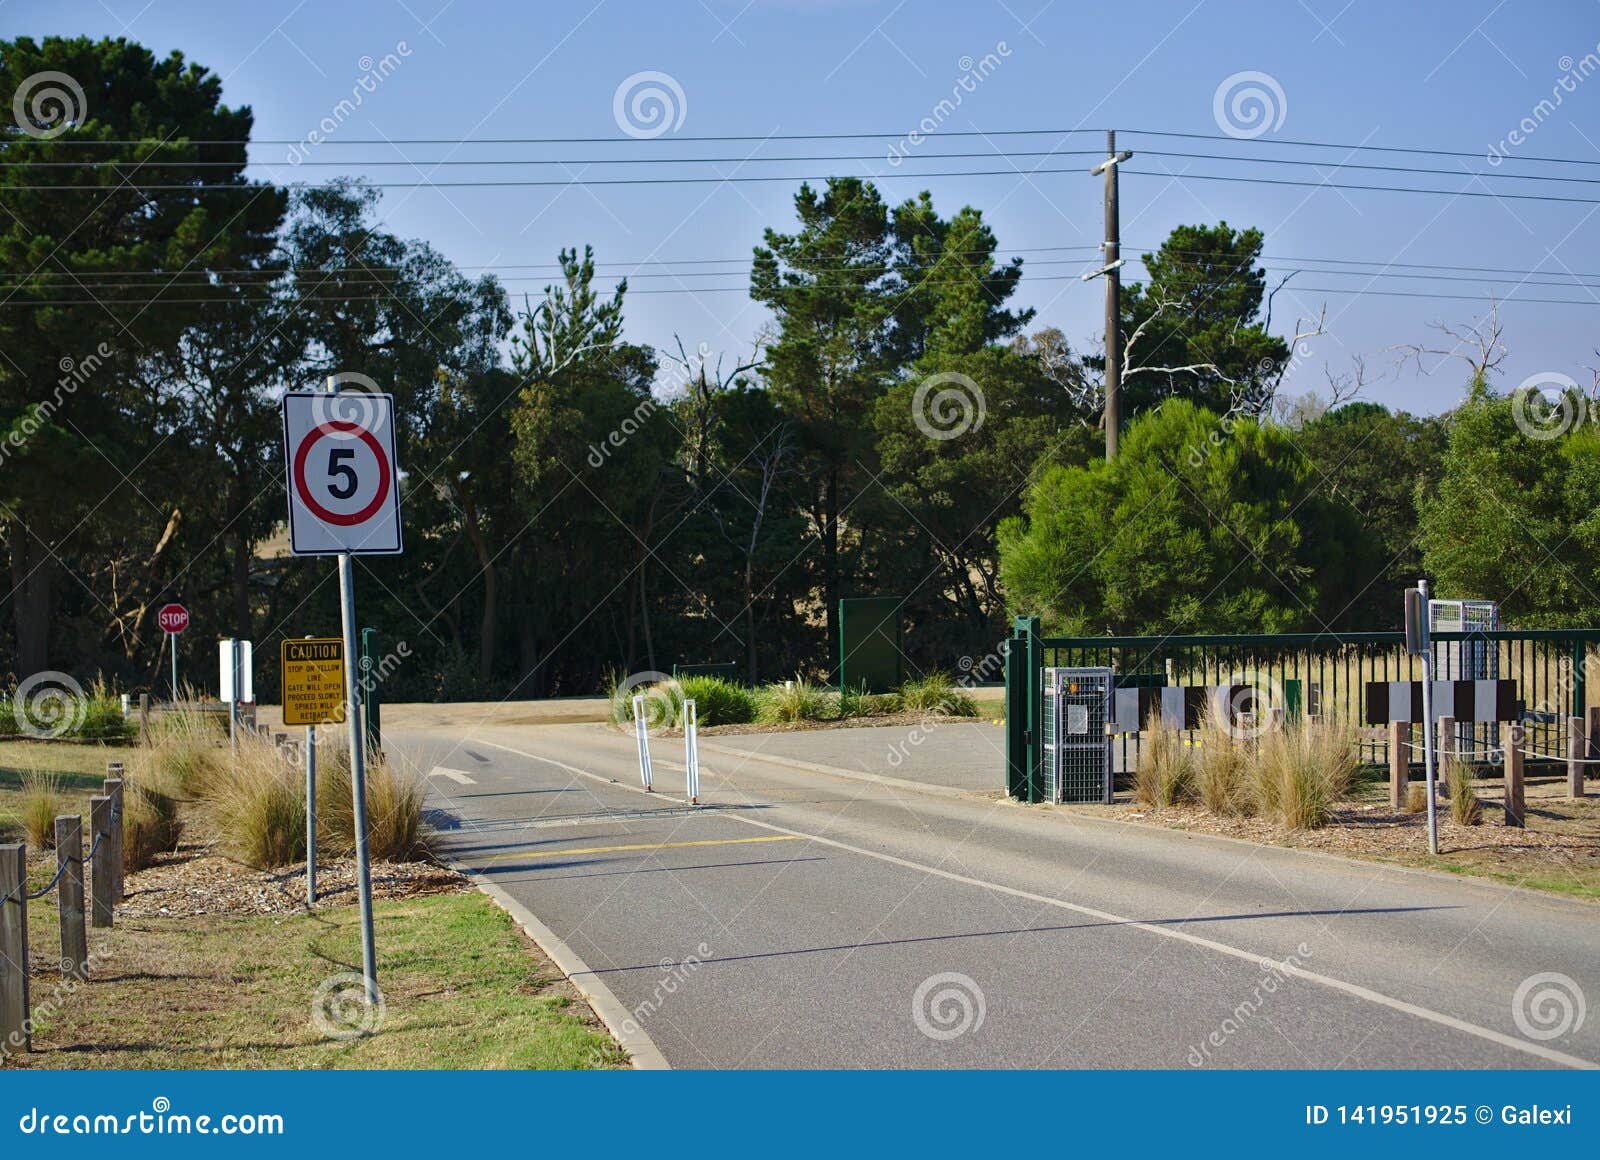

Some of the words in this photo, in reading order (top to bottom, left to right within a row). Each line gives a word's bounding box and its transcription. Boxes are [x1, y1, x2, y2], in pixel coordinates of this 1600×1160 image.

[327, 448, 358, 500] 5
[161, 612, 187, 625] STOP
[290, 644, 337, 659] CAUTION
[287, 665, 303, 673] STOP
[306, 664, 315, 672] ON
[318, 664, 340, 672] YELLOW
[307, 674, 321, 682] LINE
[287, 684, 304, 692] GATE
[287, 693, 316, 701] PROCEED
[318, 692, 340, 700] SLOWLY
[294, 702, 317, 711] SPIKES
[320, 702, 333, 710] WILL
[300, 711, 329, 721] RETRACT
